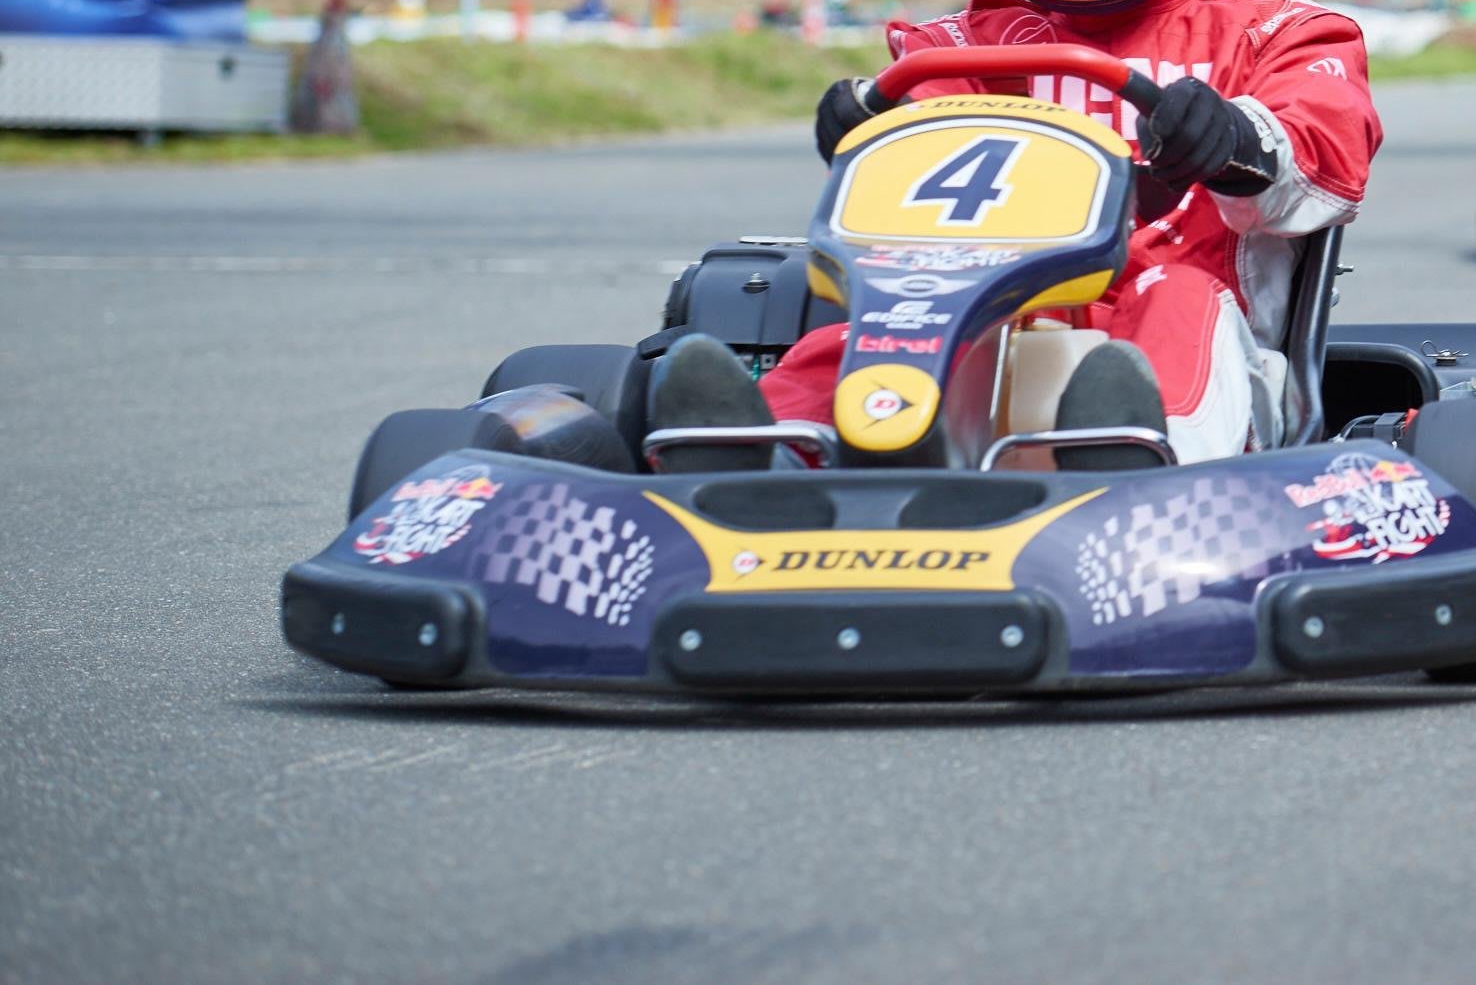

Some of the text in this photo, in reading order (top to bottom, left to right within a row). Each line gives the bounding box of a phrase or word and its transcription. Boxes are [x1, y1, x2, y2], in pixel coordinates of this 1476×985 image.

[929, 100, 1067, 112] DUNLOP
[906, 136, 1026, 225] 4
[771, 550, 992, 571] DUNLOP
